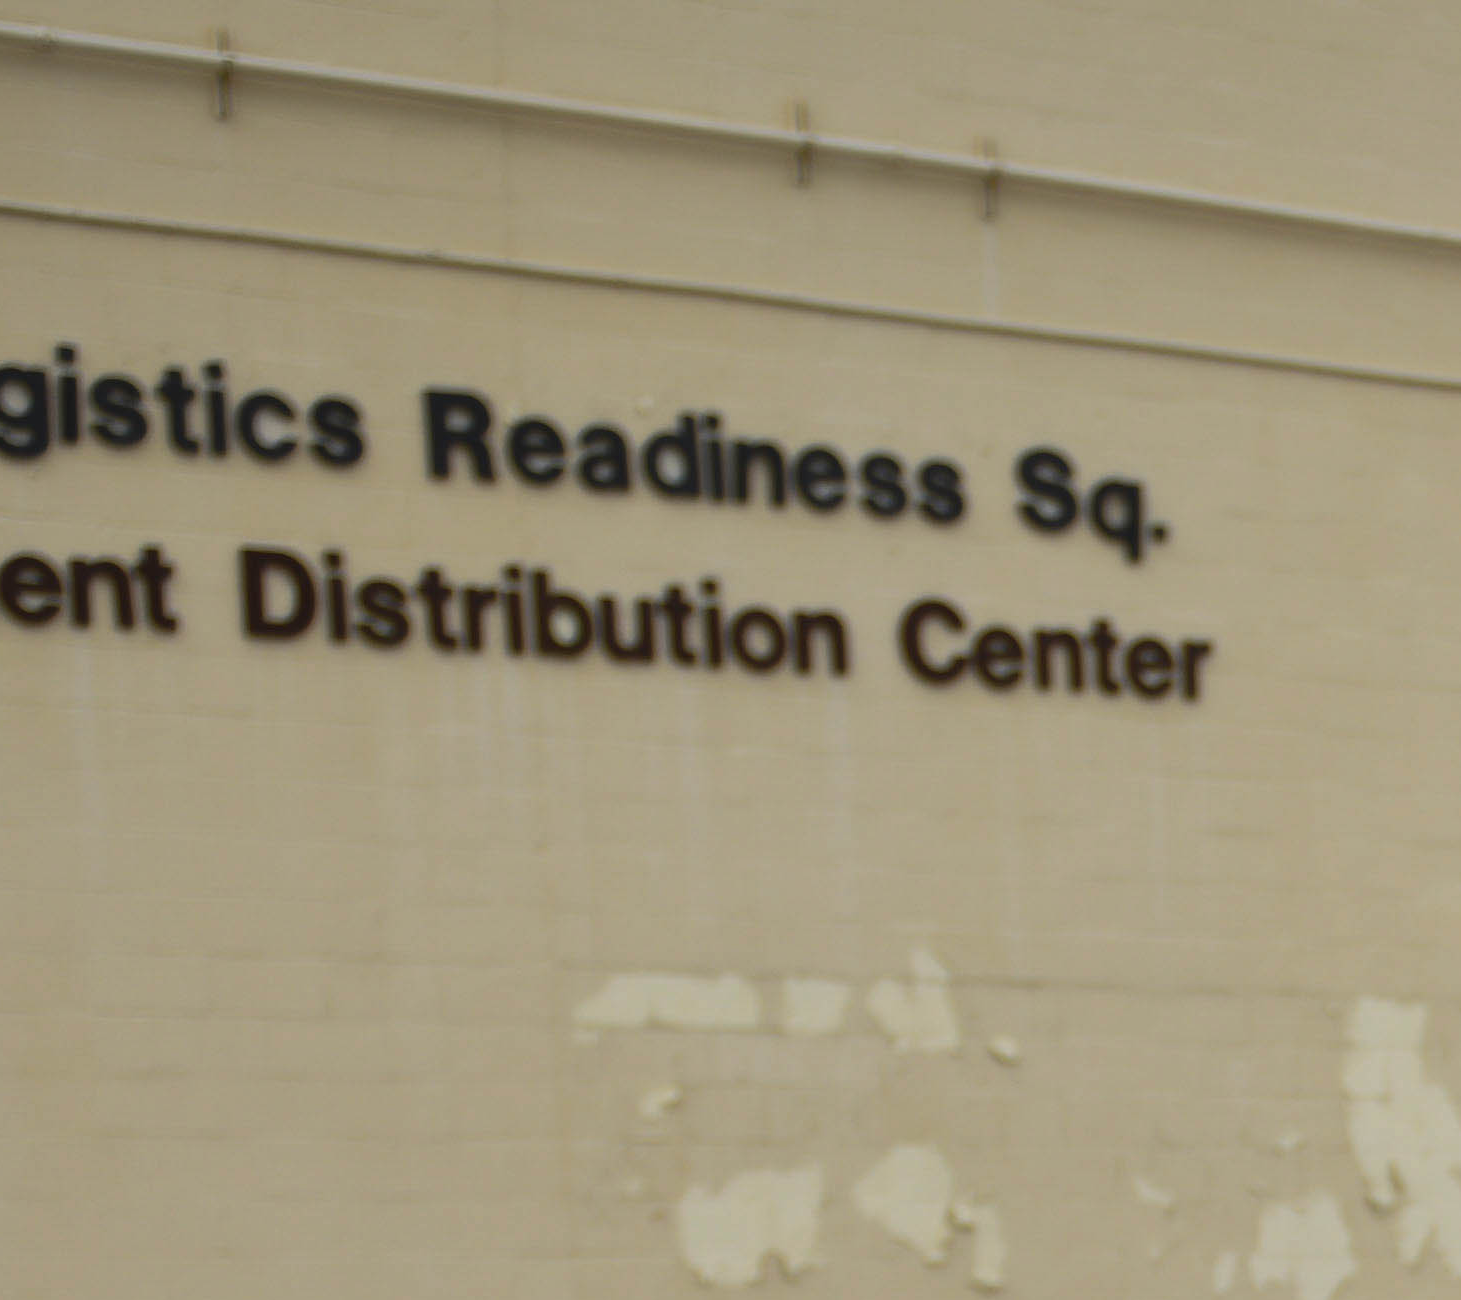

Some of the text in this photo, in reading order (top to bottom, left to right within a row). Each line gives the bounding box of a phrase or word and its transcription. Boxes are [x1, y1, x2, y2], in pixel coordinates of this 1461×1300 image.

[421, 387, 967, 525] Readiness
[1016, 446, 1169, 563] Sq.
[236, 544, 850, 675] Distribution
[898, 597, 1213, 703] Center
